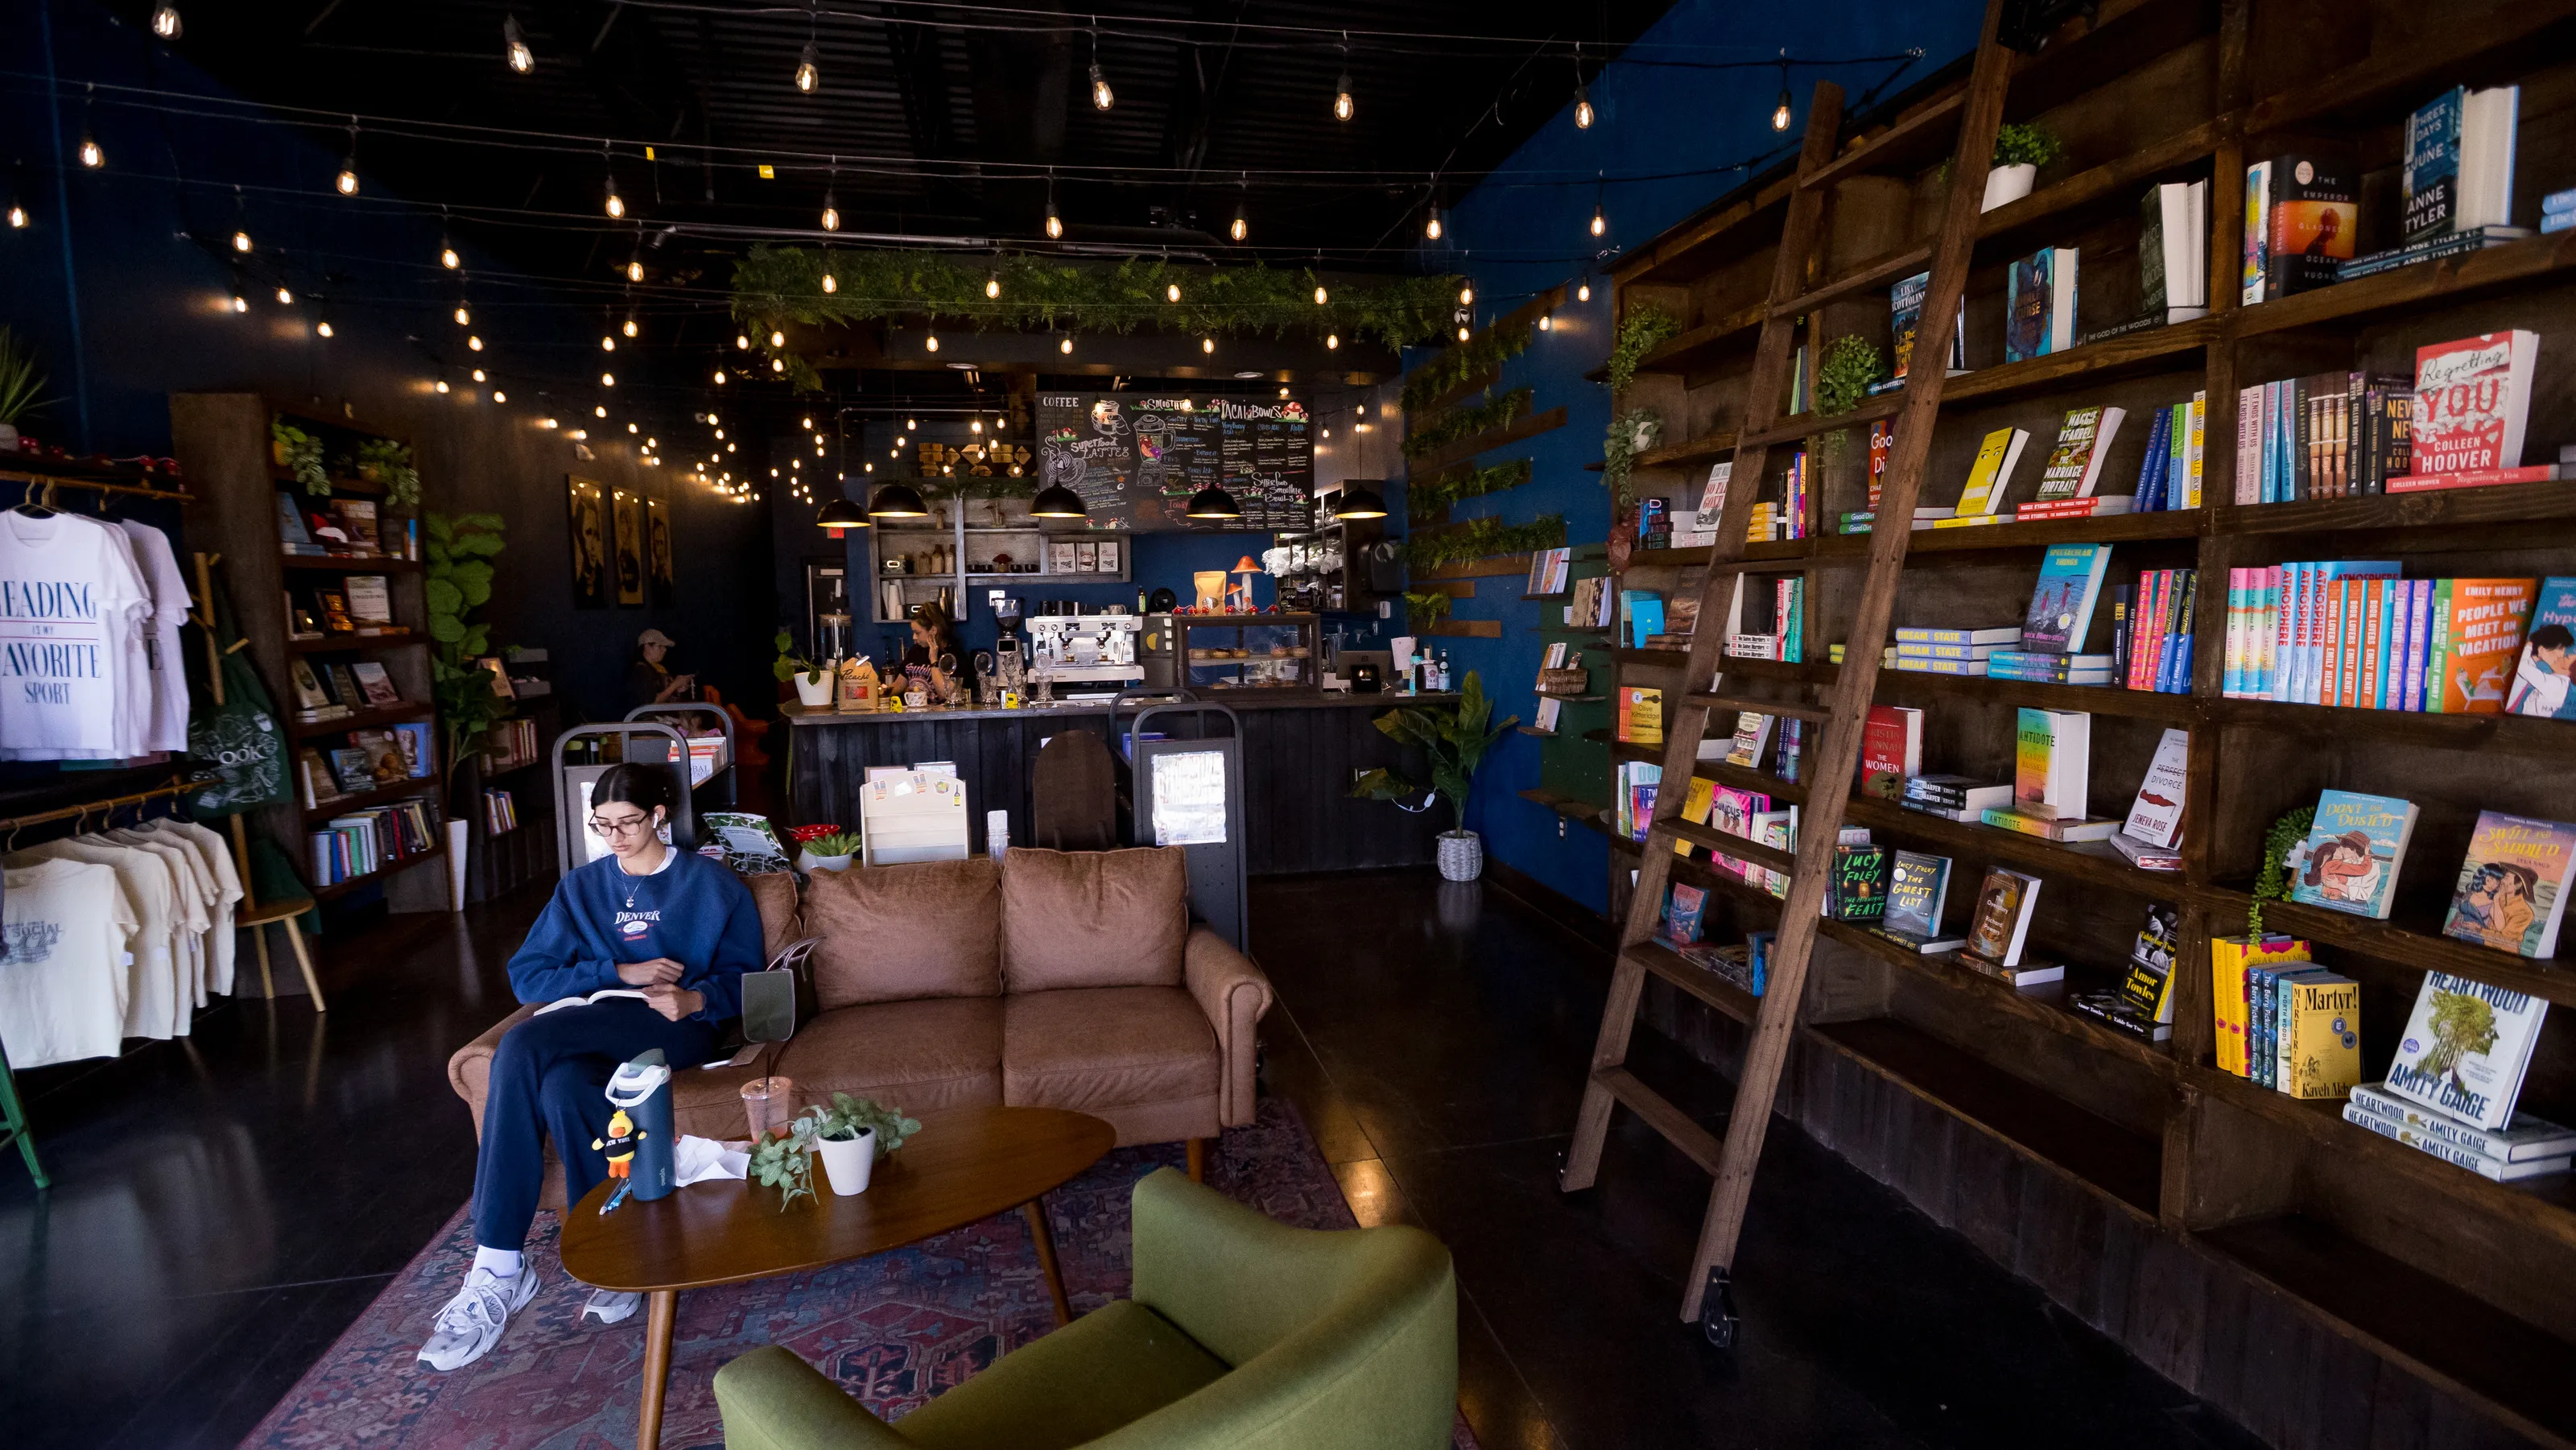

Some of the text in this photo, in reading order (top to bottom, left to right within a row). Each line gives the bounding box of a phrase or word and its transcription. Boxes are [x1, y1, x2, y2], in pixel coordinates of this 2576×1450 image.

[2414, 102, 2446, 124] THREE
[2415, 119, 2442, 142] DAYS
[2413, 143, 2445, 170] JUNE
[2318, 176, 2337, 185] THE
[2303, 191, 2350, 201] EMPEROR
[2407, 184, 2446, 214] ANNE
[2405, 204, 2446, 233] TYLER
[2404, 233, 2461, 253] ANNE TYLER
[2306, 254, 2338, 264] OCEAN
[2403, 246, 2460, 266] ANNE TYLER
[2097, 319, 2152, 339] GOD WOODS
[2423, 351, 2505, 383] Regretting
[1043, 396, 1079, 407] COFFEE
[1147, 399, 1192, 411] SMOOTHIS
[2421, 378, 2500, 423] YOU
[1251, 405, 1282, 419] BOWLS
[2068, 411, 2098, 427] MAGGIE
[1871, 433, 1893, 450] Goo
[2250, 437, 2256, 448] US
[2434, 436, 2481, 452] COLLEEN
[1082, 447, 1129, 459] LATTES
[2136, 411, 2161, 500] HAMNET MAGGIE O'FARRELL
[2192, 395, 2204, 506] INTERMEZZO SALLY ROONEY
[2421, 448, 2492, 473] HOOVER
[2044, 465, 2084, 479] MARRIAGE
[2039, 480, 2078, 493] PORTRAIT
[1852, 512, 1875, 521] Good Dirt
[1849, 524, 1863, 532] Good
[0, 579, 97, 619] EADING
[2465, 586, 2524, 597] EMILY HENRY
[2278, 570, 2293, 647] ATMOSPHERE
[2296, 569, 2311, 647] ATMOSPHERE
[2311, 569, 2326, 647] ATMOSPHERE
[2458, 602, 2504, 623] PEOPLE
[2508, 599, 2529, 613] WE
[1897, 630, 1960, 642] DREAM STATE
[2465, 620, 2516, 638] MEET ON
[1899, 645, 1962, 657] DREAM STATE
[2324, 600, 2338, 693] BOOK LOVERS EMILY HENRY
[2344, 600, 2359, 694] BOOK LOVERS EMILY HENRY
[2363, 600, 2378, 695] BOOK LOVERS EMILY HENRY
[2458, 634, 2520, 657] VACATION
[2, 643, 103, 679] AVORITE
[1898, 659, 1958, 672] DREAM STATE
[2434, 651, 2442, 673] EMILY
[25, 682, 71, 704] SPORT
[1632, 712, 1660, 721] Kitteridge
[1870, 728, 1900, 740] RISTIN
[2019, 730, 2055, 747] ANTIDOTE
[1870, 741, 1901, 754] ANNAH
[1877, 754, 1887, 762] THE
[2024, 752, 2048, 762] KAREN
[1865, 759, 1899, 773] WOMEN
[2151, 775, 2182, 790] DIVORCE
[1989, 815, 2021, 829] ANTIDOTE
[2133, 813, 2168, 832] JENEVA ROSE
[2337, 813, 2394, 828] DUSTED
[1843, 853, 1883, 871] LUCY
[1896, 861, 1937, 875] LUCY FOLEY
[1844, 870, 1881, 884] FOLEY
[1906, 874, 1924, 883] THE
[1893, 882, 1932, 899] GUEST
[1995, 894, 2003, 903] The
[1844, 903, 1885, 916] FEAST
[1900, 896, 1923, 907] LIST
[1987, 899, 2009, 915] Overstory
[613, 911, 660, 924] DENVER
[1985, 915, 2004, 928] Richard
[1984, 923, 2000, 936] Powers
[1893, 936, 1907, 945] GUEST
[2140, 931, 2176, 952] Table Two
[2131, 967, 2157, 987] Amor
[2125, 977, 2156, 1002] Towles
[2429, 970, 2530, 1015] HEARTWOOD
[2263, 989, 2271, 1009] Berry
[2305, 986, 2357, 1014] Martyr!
[2078, 1002, 2125, 1027] Amor Table
[2293, 988, 2301, 1060] MARTYR!
[2302, 1083, 2330, 1097] Kaveh
[2389, 1063, 2442, 1101] AMITY
[2439, 1081, 2491, 1122] GAIGE
[2355, 1092, 2489, 1153] HEARTWOOD AMITY GAIGE
[2348, 1109, 2481, 1171] HEARTWOOD AMITY GAIGE
